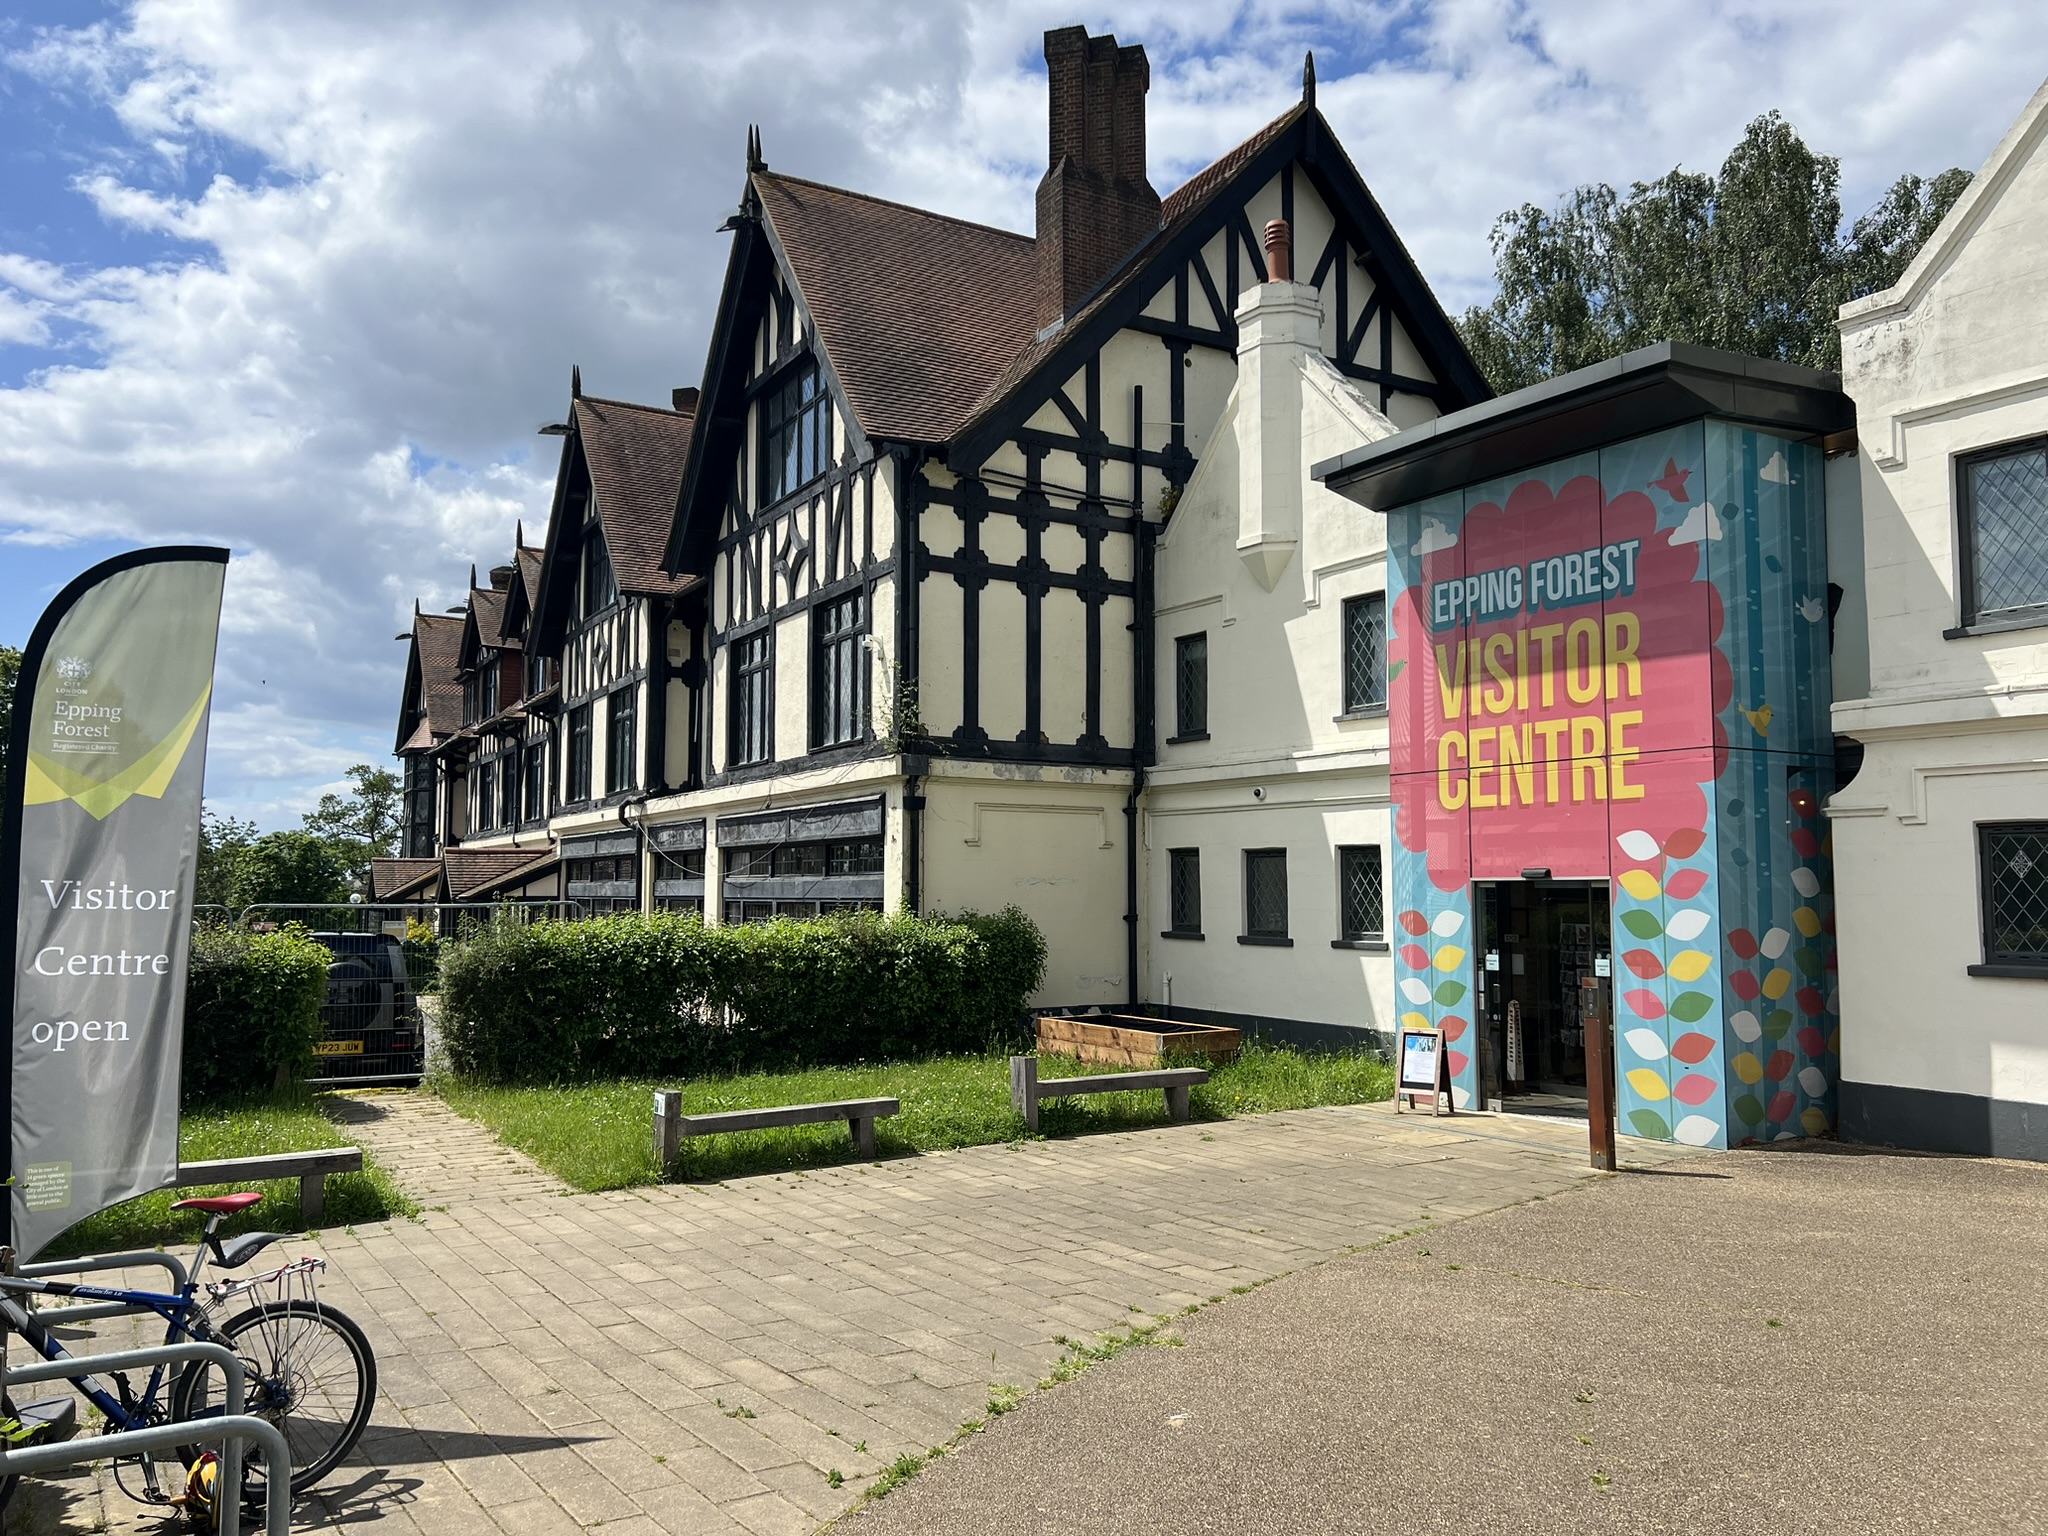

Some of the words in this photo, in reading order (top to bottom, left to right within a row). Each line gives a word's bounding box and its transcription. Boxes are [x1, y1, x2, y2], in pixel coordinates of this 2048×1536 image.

[1434, 566, 1523, 624] EPPING
[1531, 540, 1640, 605] FOREST
[1436, 611, 1643, 719] VISITOR
[55, 687, 88, 695] LONDON
[54, 700, 122, 723] Epping
[52, 720, 111, 738] Forest
[53, 742, 90, 751] Registered
[91, 744, 117, 753] Charity
[1438, 710, 1645, 810] CENTRE
[41, 879, 176, 911] Visitor
[34, 946, 170, 976] Centre
[31, 1019, 130, 1052] open
